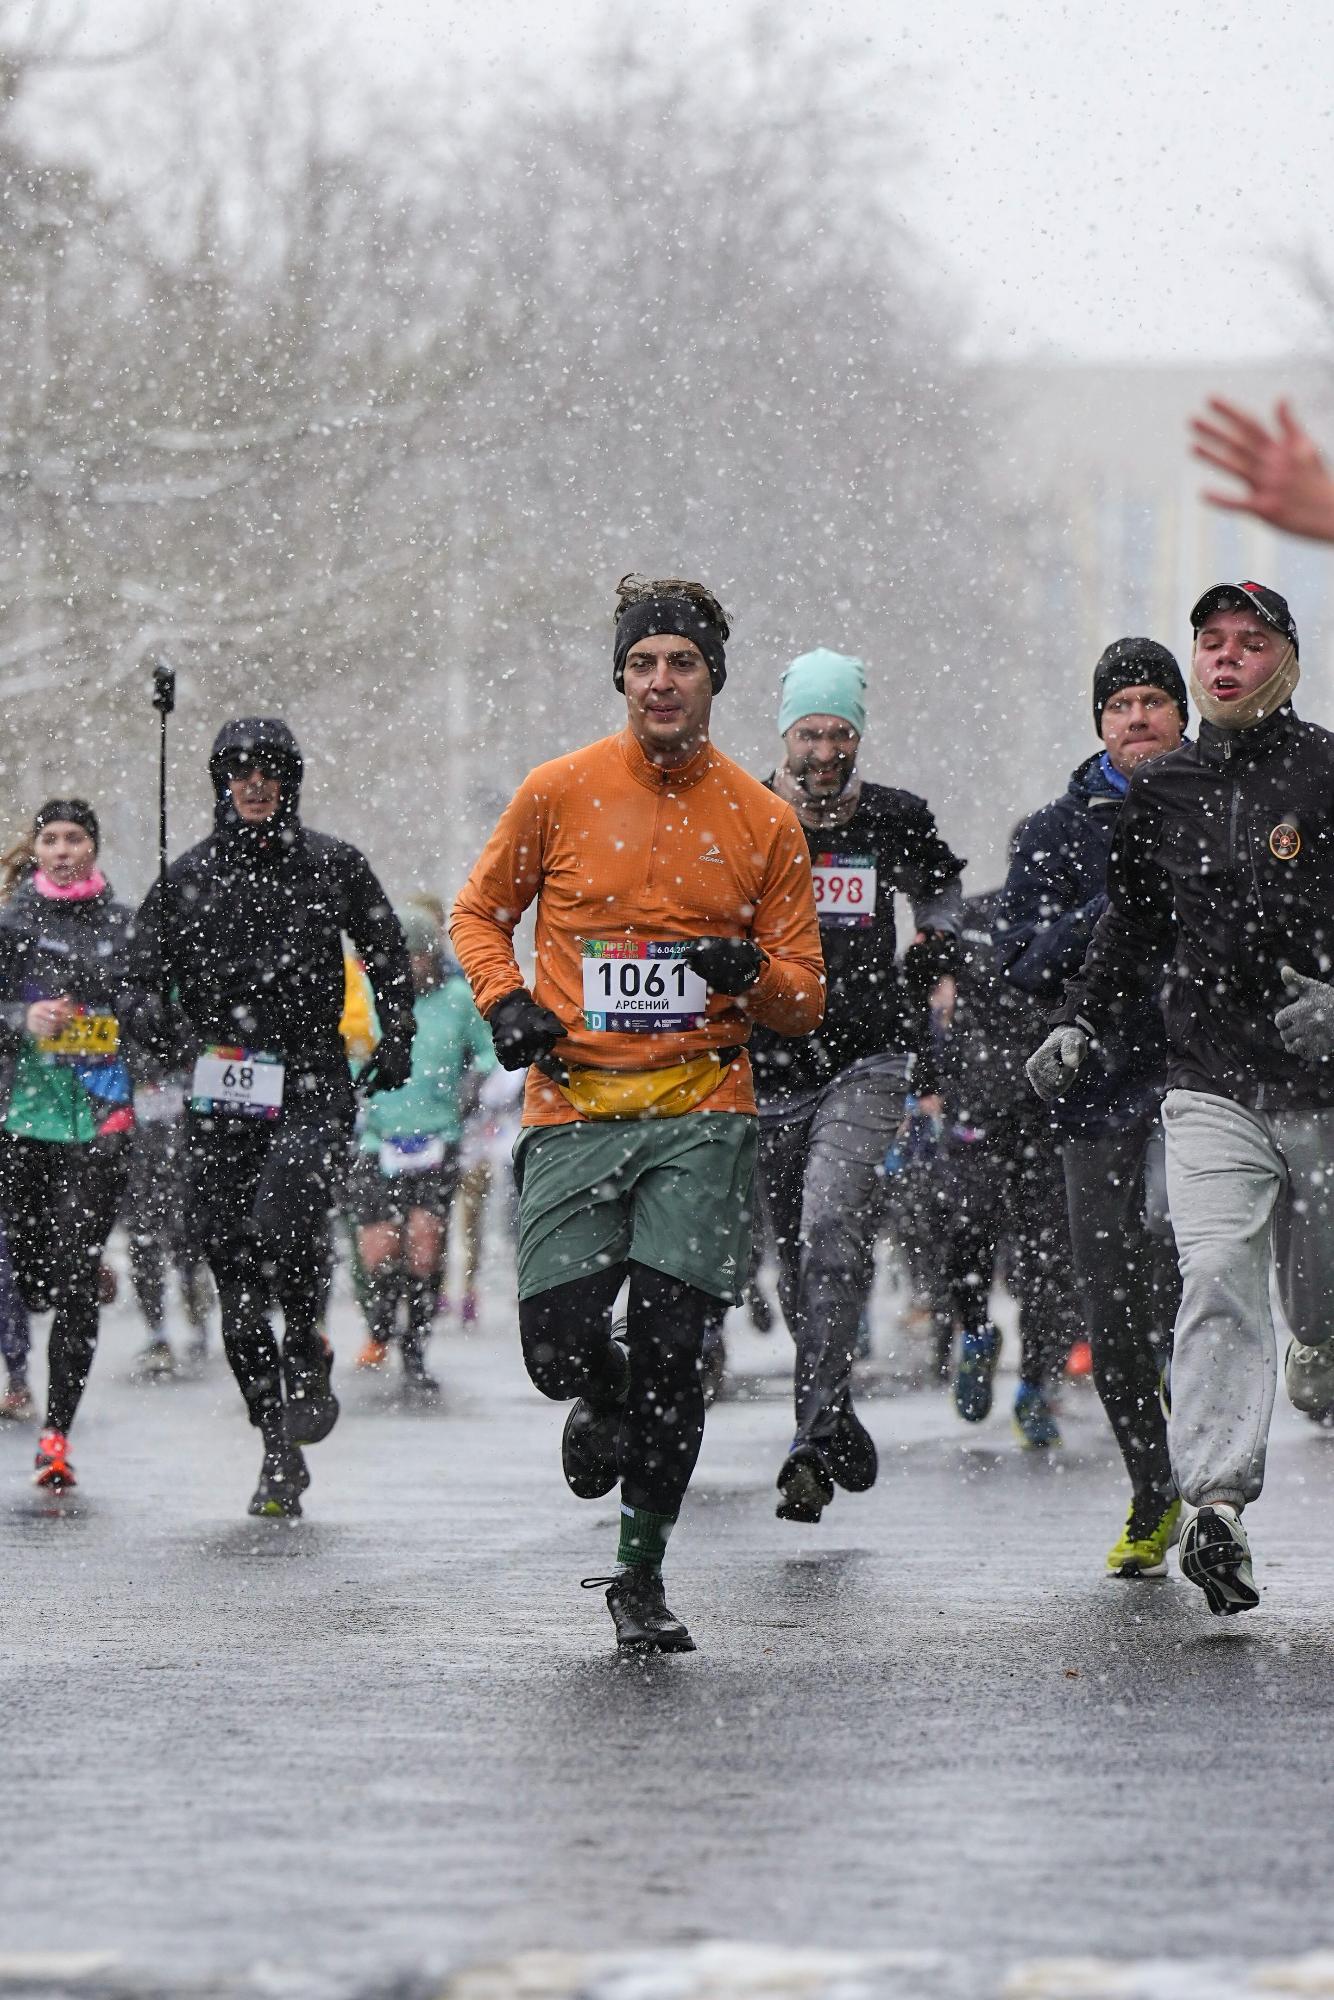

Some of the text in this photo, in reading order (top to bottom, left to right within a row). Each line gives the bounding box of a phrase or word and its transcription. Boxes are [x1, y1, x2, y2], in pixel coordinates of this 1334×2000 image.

[593, 941, 639, 952] АПРЕЛЬ
[598, 963, 686, 997] 1061
[615, 998, 669, 1010] АРСЕНИЙ
[592, 1013, 602, 1029] D
[223, 1064, 253, 1089] 68
